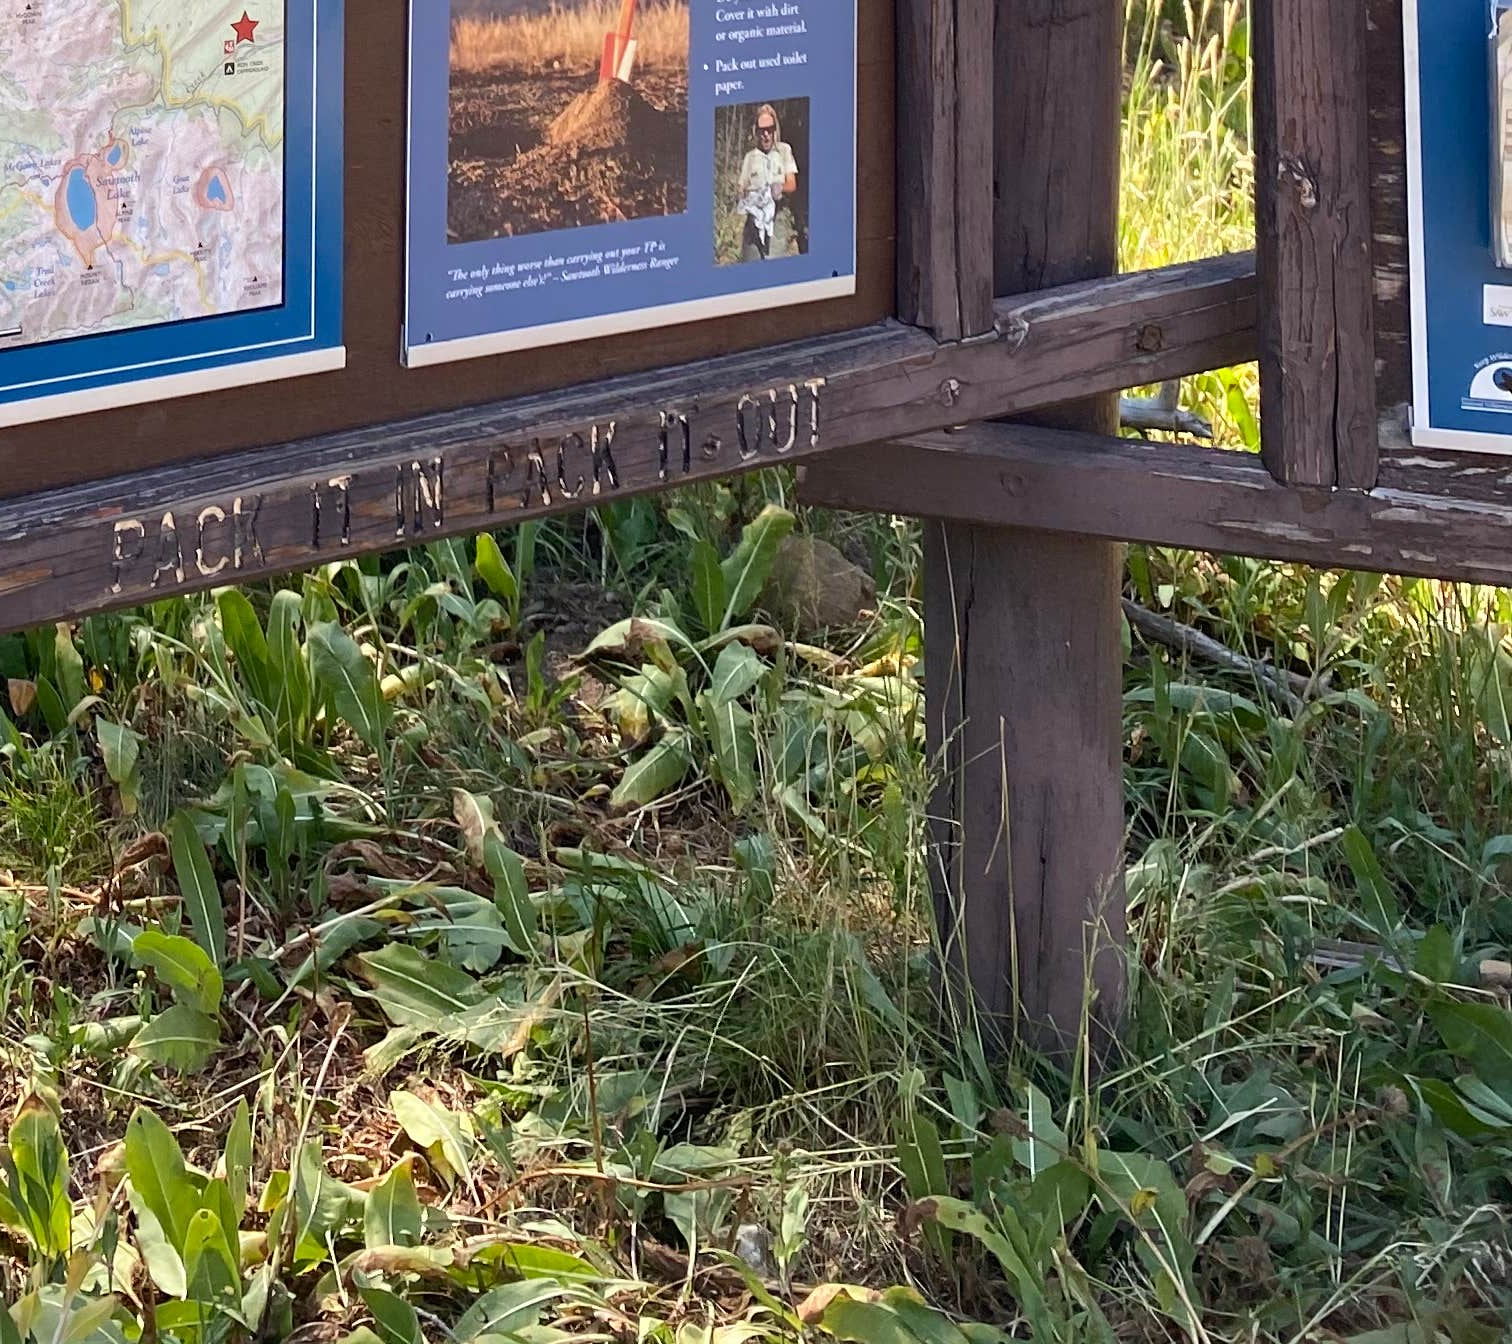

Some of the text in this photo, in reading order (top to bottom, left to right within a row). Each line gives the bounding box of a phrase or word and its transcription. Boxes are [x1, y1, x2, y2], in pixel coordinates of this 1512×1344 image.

[108, 493, 268, 595] PACK
[312, 473, 353, 549] IT
[395, 456, 445, 537] IN
[659, 409, 691, 480] IT
[737, 378, 827, 462] OUT
